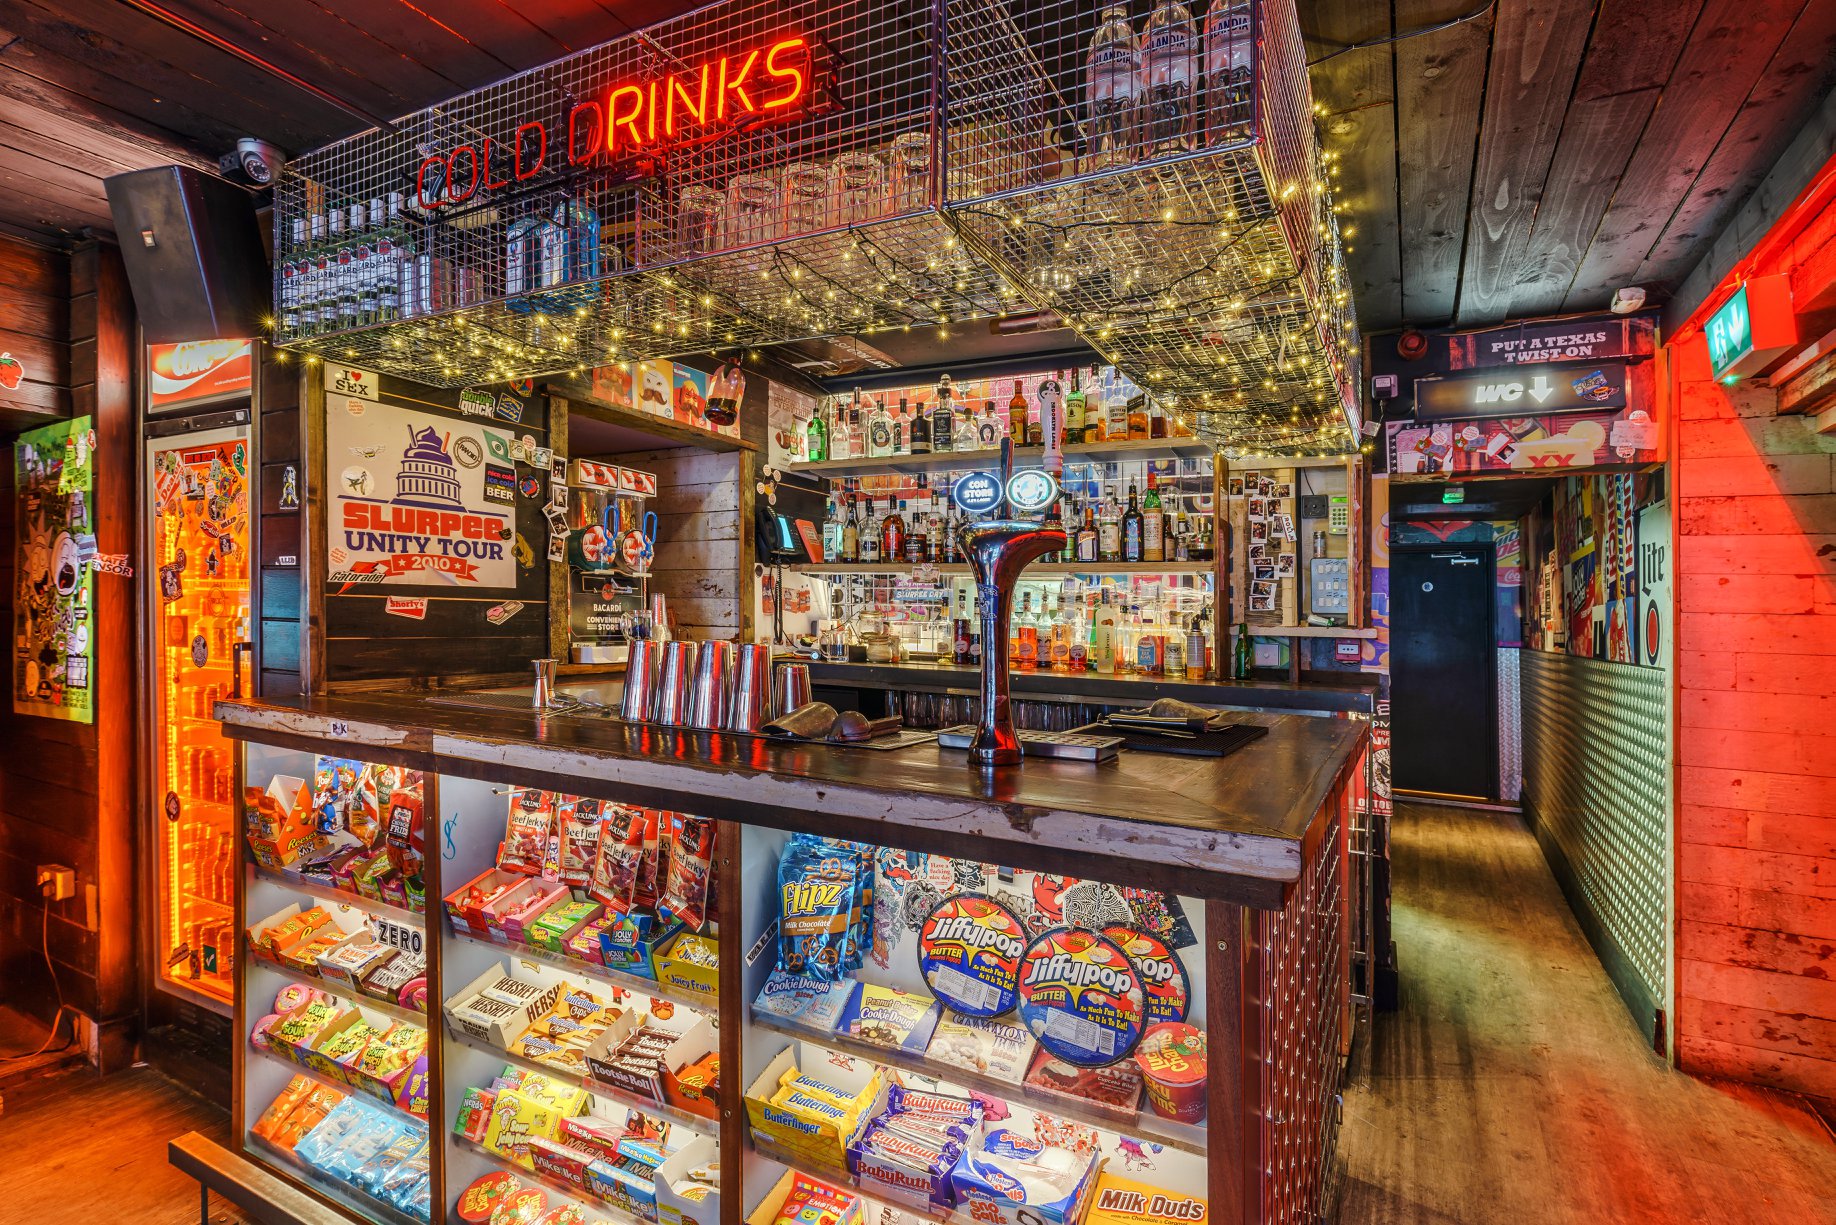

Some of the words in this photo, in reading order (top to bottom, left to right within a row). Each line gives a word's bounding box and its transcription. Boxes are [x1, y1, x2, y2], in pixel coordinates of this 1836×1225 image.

[416, 122, 546, 209] COLD
[568, 39, 803, 166] DRINKS
[1491, 340, 1529, 353] PUT
[1531, 338, 1543, 349] A
[1545, 331, 1607, 347] TEXAS
[1504, 349, 1561, 363] TWIST
[1565, 344, 1593, 357] ON
[343, 369, 350, 381] I
[335, 379, 369, 396] SEX
[1476, 382, 1523, 404] WC
[462, 390, 495, 405] double
[460, 401, 494, 418] quick
[487, 470, 502, 478] nice
[502, 473, 515, 481] cold
[487, 476, 499, 484] ice
[499, 479, 515, 487] cold
[968, 480, 988, 489] CON
[486, 486, 514, 501] BEER
[963, 488, 993, 498] STORE
[1606, 476, 1618, 584] RUNCH
[344, 530, 431, 553] UNITY
[438, 538, 504, 560] TOUR
[411, 556, 451, 571] 2010
[1641, 541, 1665, 598] Lite
[329, 571, 384, 584] Gatorade
[929, 590, 944, 598] DAY
[390, 599, 424, 609] Shorty's
[511, 813, 526, 823] Beef
[564, 826, 583, 837] Beef
[601, 839, 615, 853] Beef
[673, 846, 686, 863] Beef
[781, 881, 843, 920] Flipz
[785, 921, 798, 929] Milk
[799, 920, 831, 929] Chocolate
[379, 921, 422, 956] ZERO
[614, 930, 632, 939] JOLLY
[608, 950, 624, 958] JOLLY
[930, 947, 963, 959] BUTTER
[980, 965, 994, 974] Much
[993, 968, 1004, 977] Fun
[1005, 971, 1013, 980] To
[670, 974, 690, 988] Juicy
[691, 979, 712, 991] Fruit
[764, 979, 799, 995] Cookie
[799, 976, 831, 993] Dough
[996, 978, 1004, 987] To
[1003, 982, 1015, 991] Eat!
[563, 990, 602, 1012] Butterfinger
[795, 991, 814, 999] Bites
[1030, 990, 1067, 1002] BUTTER
[865, 997, 893, 1007] Peanut
[893, 1001, 918, 1014] Butter
[1160, 998, 1167, 1006] To
[1167, 999, 1183, 1008] Make
[570, 1006, 587, 1018] Cups
[860, 1006, 890, 1020] Cookie
[889, 1010, 917, 1031] Dough
[1087, 1006, 1103, 1015] Much
[1103, 1009, 1115, 1017] Fun
[1124, 1011, 1140, 1023] Make
[1153, 1006, 1160, 1014] To
[1160, 1007, 1172, 1016] Eat!
[545, 1015, 587, 1031] Butterfinger
[549, 1026, 569, 1034] Cups
[1107, 1018, 1115, 1027] To
[1116, 1019, 1128, 1031] Eat!
[519, 1034, 563, 1052] Butterfinger
[637, 1035, 667, 1050] Tootsie
[630, 1045, 661, 1056] Tootsie
[620, 1054, 647, 1066] Tootsie
[591, 1062, 629, 1083] Tootsie
[628, 1074, 652, 1091] Roll
[794, 1074, 855, 1100] Butterfinger
[509, 1118, 530, 1133] Sour
[763, 1107, 821, 1134] Butterfinger
[494, 1131, 515, 1149] Jelly
[533, 1153, 561, 1174] Mike
[595, 1179, 626, 1201] Mike
[1098, 1189, 1147, 1213] Milk
[1149, 1195, 1205, 1220] Duds
[1131, 1215, 1159, 1224] Chocolate
